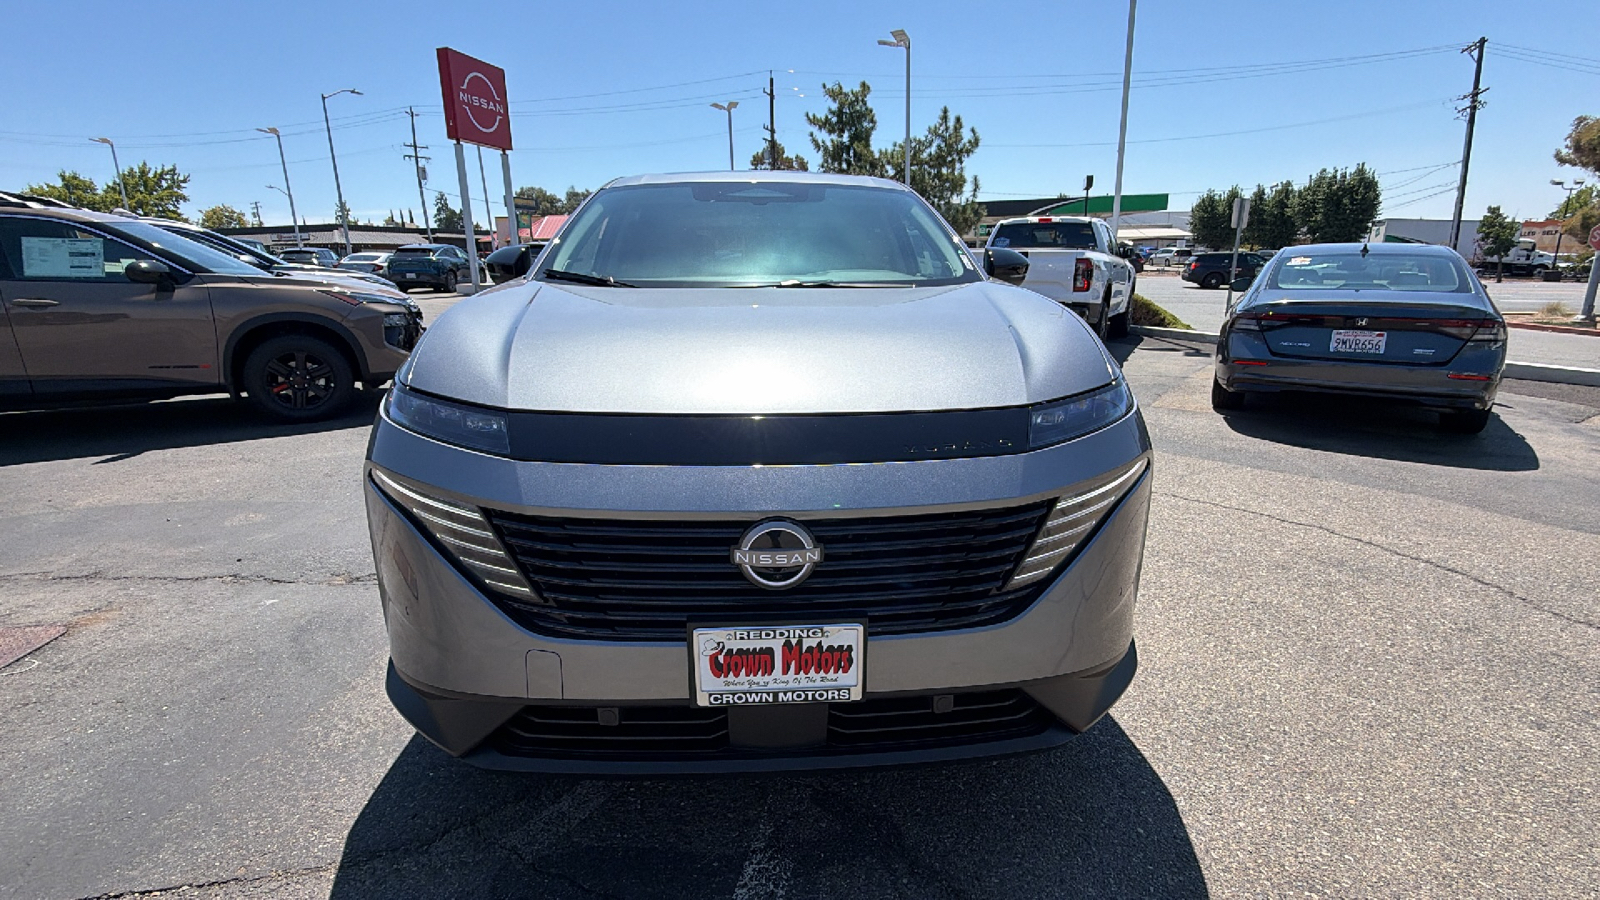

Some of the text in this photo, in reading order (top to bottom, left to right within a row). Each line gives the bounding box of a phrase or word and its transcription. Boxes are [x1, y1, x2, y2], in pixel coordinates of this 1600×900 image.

[460, 91, 504, 114] NISSAN
[1334, 337, 1382, 350] 9MVR656
[736, 550, 820, 564] NISSAN
[735, 629, 823, 640] REDDING
[709, 639, 854, 679] Crown Motors
[772, 677, 790, 687] King
[804, 676, 818, 684] The
[711, 690, 850, 704] CROWN MOTORS
